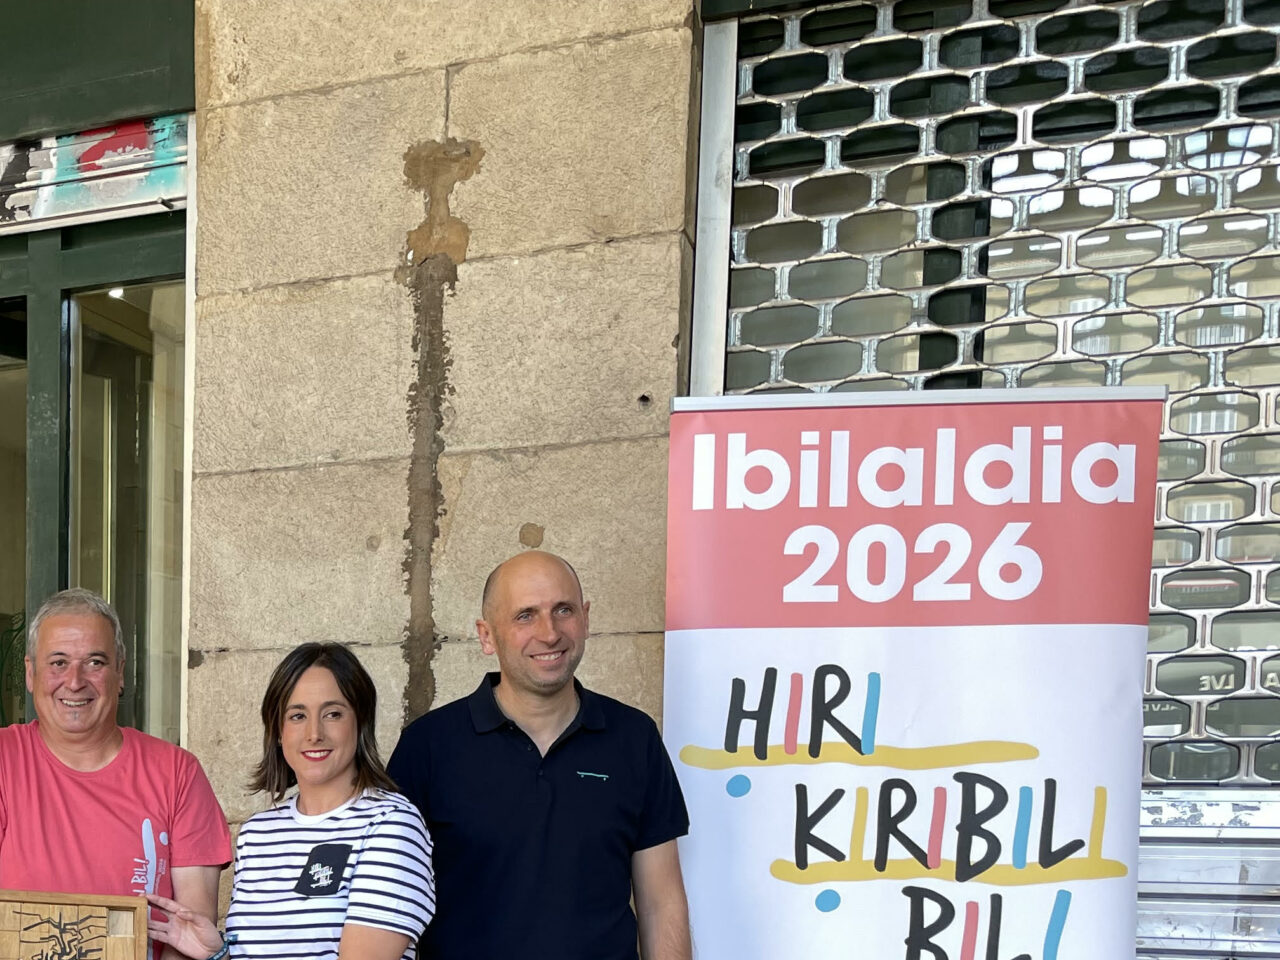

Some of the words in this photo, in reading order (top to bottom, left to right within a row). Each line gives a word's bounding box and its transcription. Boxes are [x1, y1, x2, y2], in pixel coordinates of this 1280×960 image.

[692, 426, 1136, 511] Ibilaldia
[782, 522, 1043, 603] 2026
[724, 664, 881, 761] HIRI
[795, 772, 1107, 882] KIRIBILI
